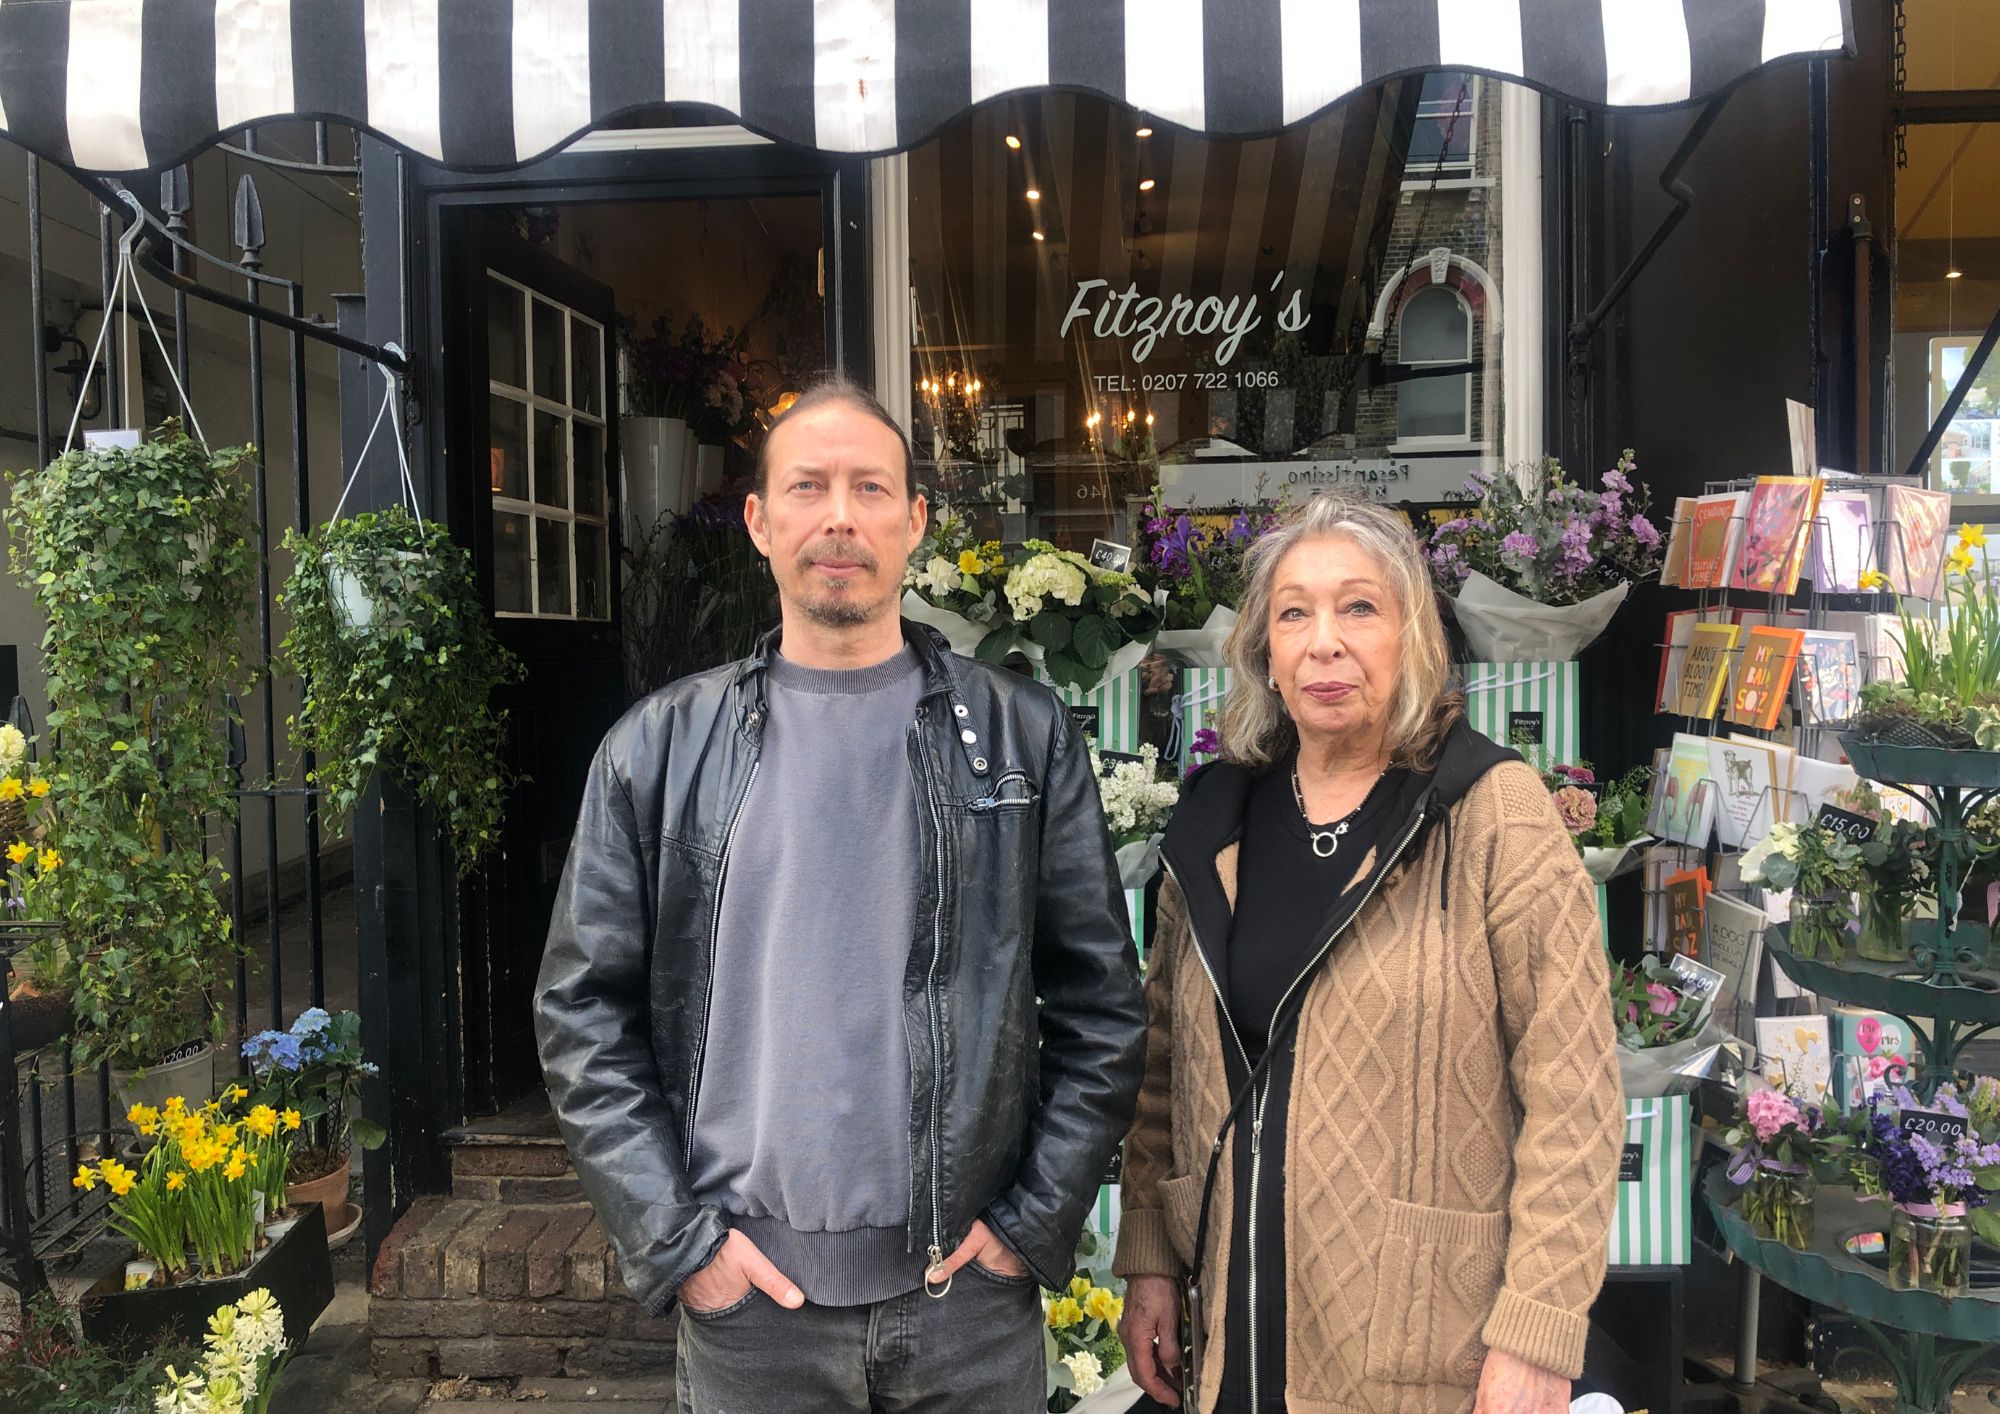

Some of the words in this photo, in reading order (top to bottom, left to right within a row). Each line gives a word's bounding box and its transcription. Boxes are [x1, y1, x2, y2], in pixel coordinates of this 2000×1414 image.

[1060, 270, 1311, 366] Fitzroy's
[1093, 375, 1136, 392] TEL:
[1142, 374, 1188, 391] 0207
[1194, 372, 1227, 389] 722
[1235, 371, 1279, 388] 1066
[1755, 645, 1773, 662] MY
[1684, 663, 1715, 680] BLOOY
[1820, 814, 1870, 839] £15.00
[1881, 1036, 1900, 1046] Mrs
[1904, 1117, 1961, 1136] £20.00
